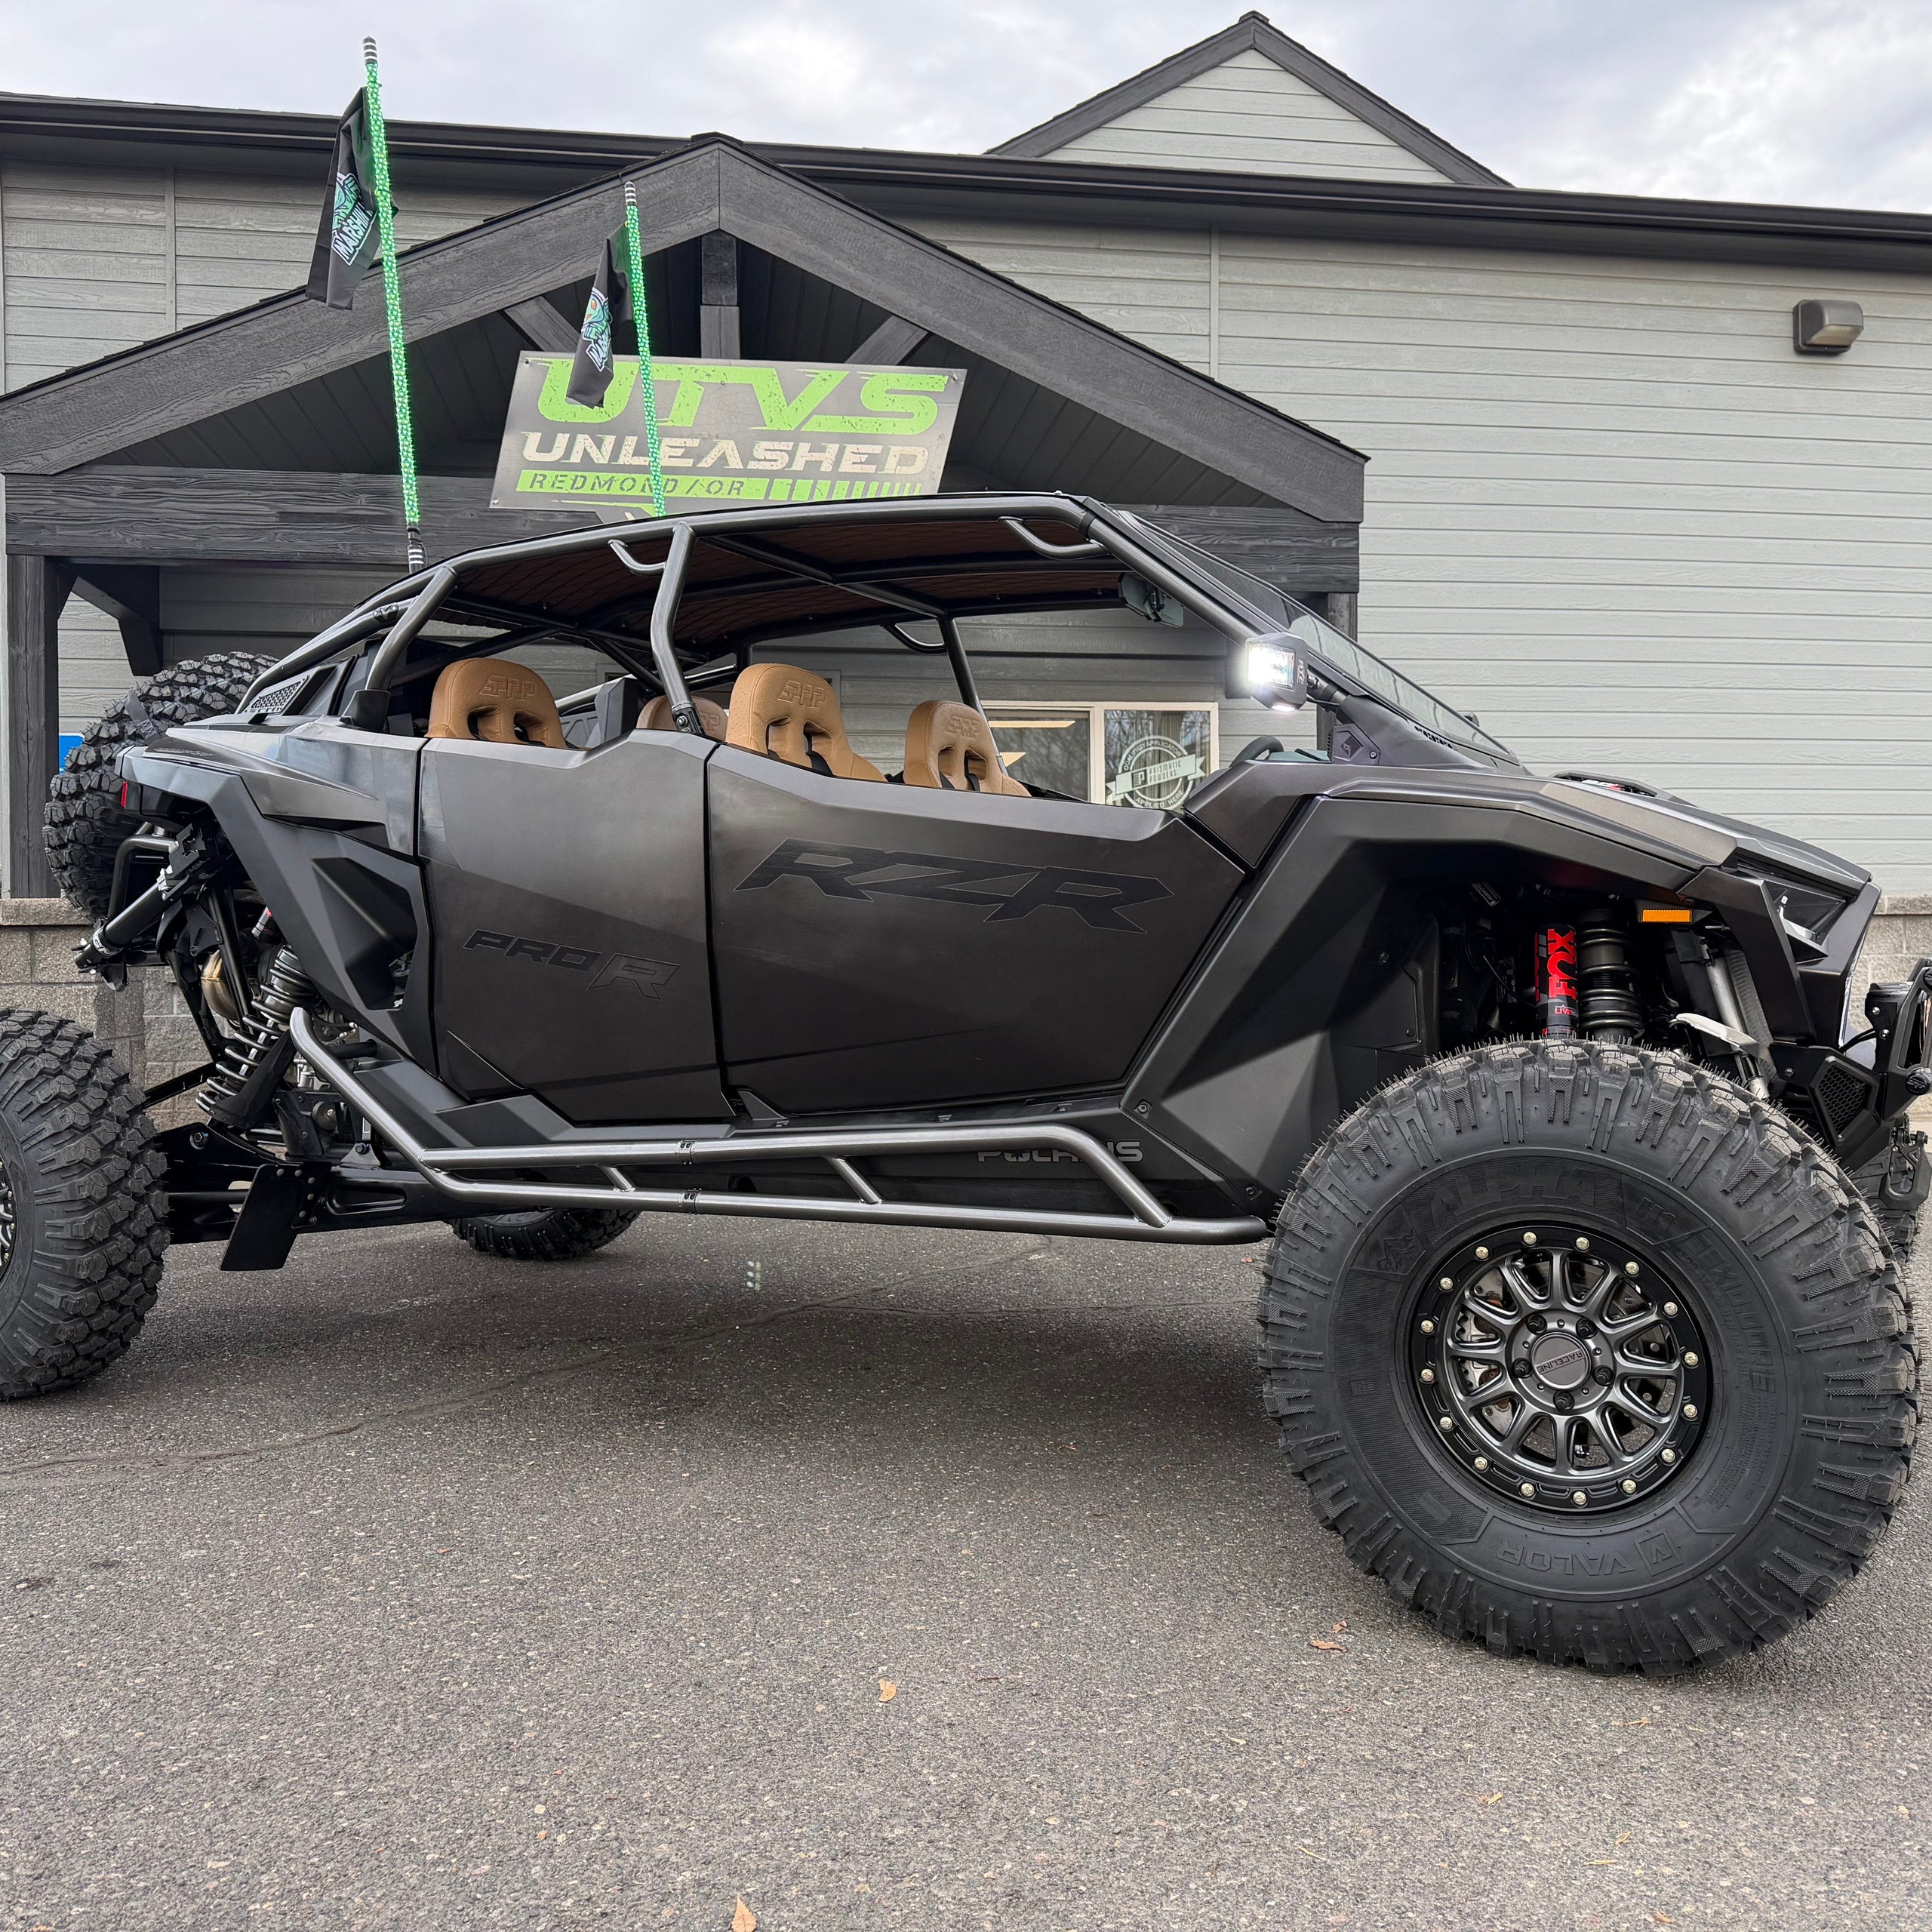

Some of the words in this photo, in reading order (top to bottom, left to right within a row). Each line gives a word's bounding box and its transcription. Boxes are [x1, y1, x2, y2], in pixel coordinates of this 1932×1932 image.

[523, 358, 948, 435] UTVS
[521, 432, 929, 475] UNLEASHED
[1146, 740, 1182, 757] APPLICATOR
[1149, 760, 1183, 774] PRISMATIC
[1149, 770, 1178, 783] POWDERS
[1136, 797, 1165, 809] APPLIED
[1168, 788, 1185, 804] HERE
[734, 838, 1174, 934] RZR
[462, 928, 603, 971] PRO
[587, 952, 681, 1000] R
[1547, 928, 1578, 1001] FOX
[1430, 1168, 1596, 1230] ALPHA
[1537, 1350, 1583, 1375] RACELINE
[1496, 1540, 1635, 1577] VALOR
